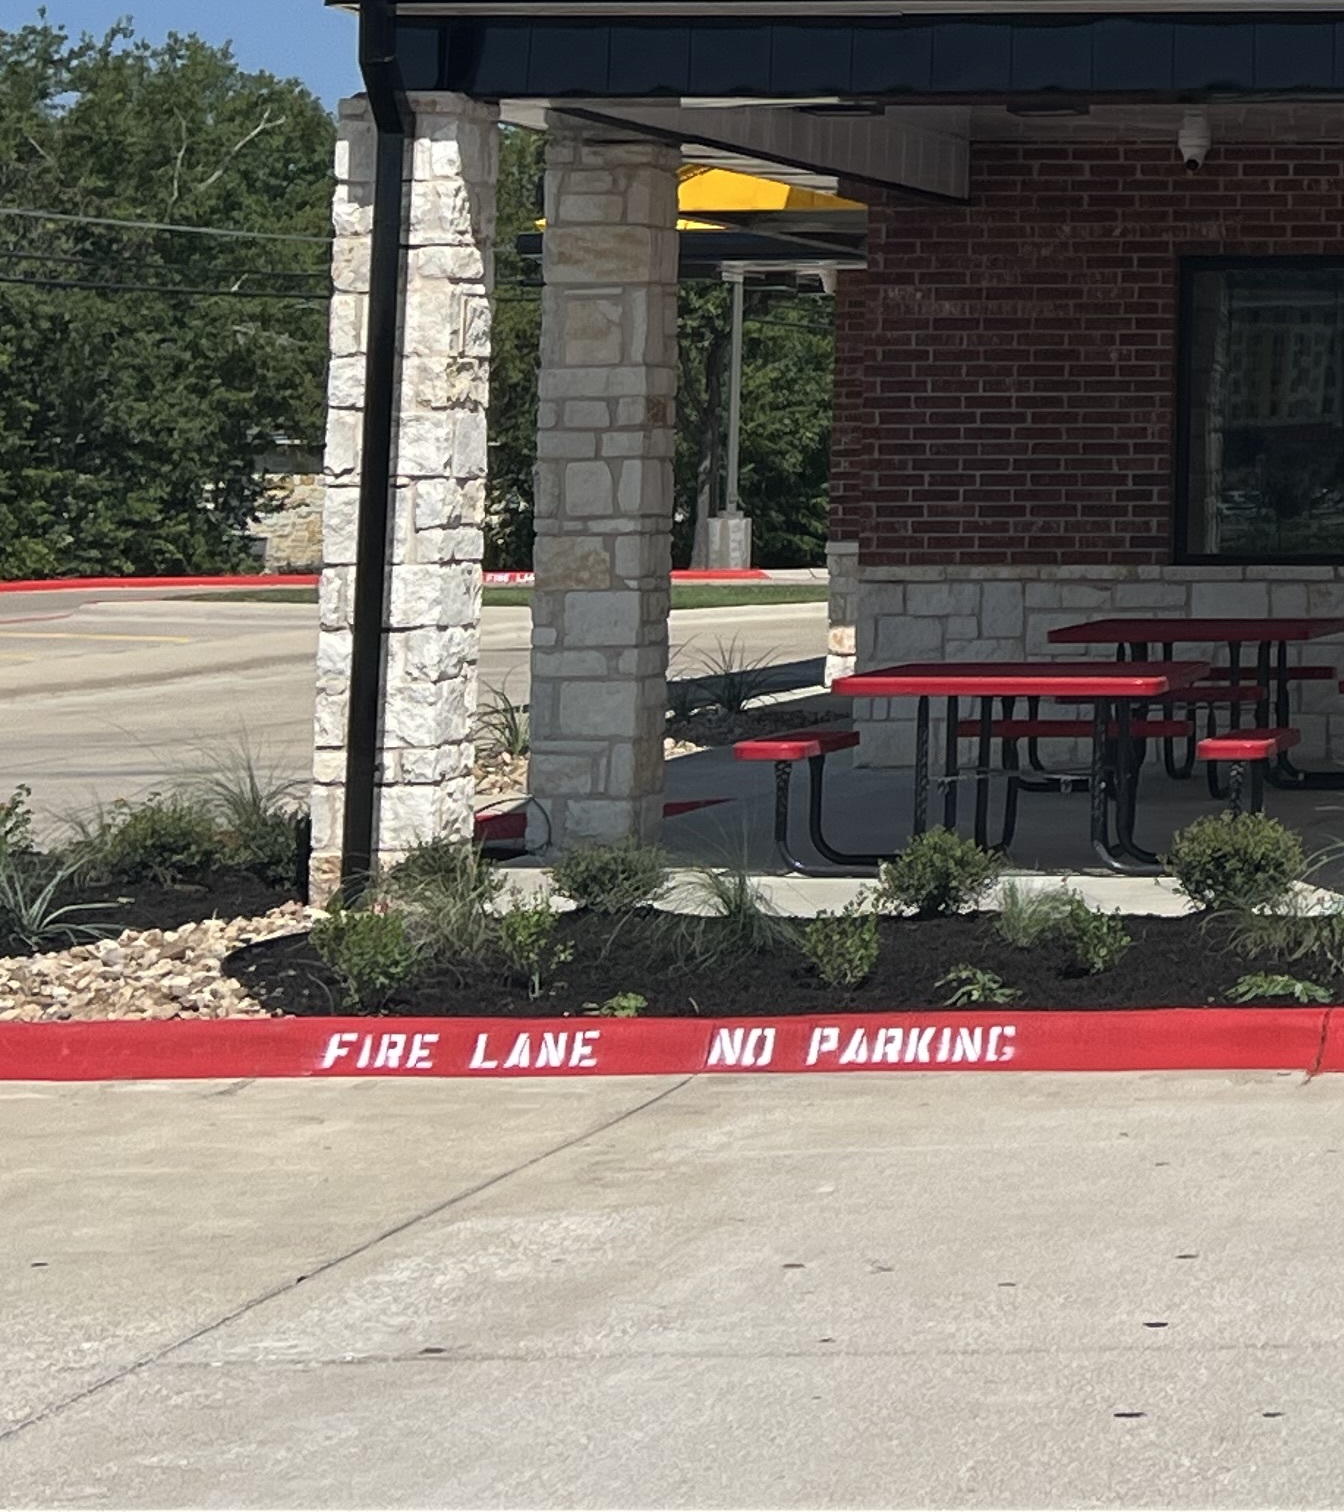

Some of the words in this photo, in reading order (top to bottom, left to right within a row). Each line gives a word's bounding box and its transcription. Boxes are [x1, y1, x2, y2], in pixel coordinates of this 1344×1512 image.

[320, 1032, 439, 1069] FIRE
[468, 1029, 601, 1069] LANE
[707, 1027, 776, 1067] NO
[805, 1025, 1017, 1065] PARKING
